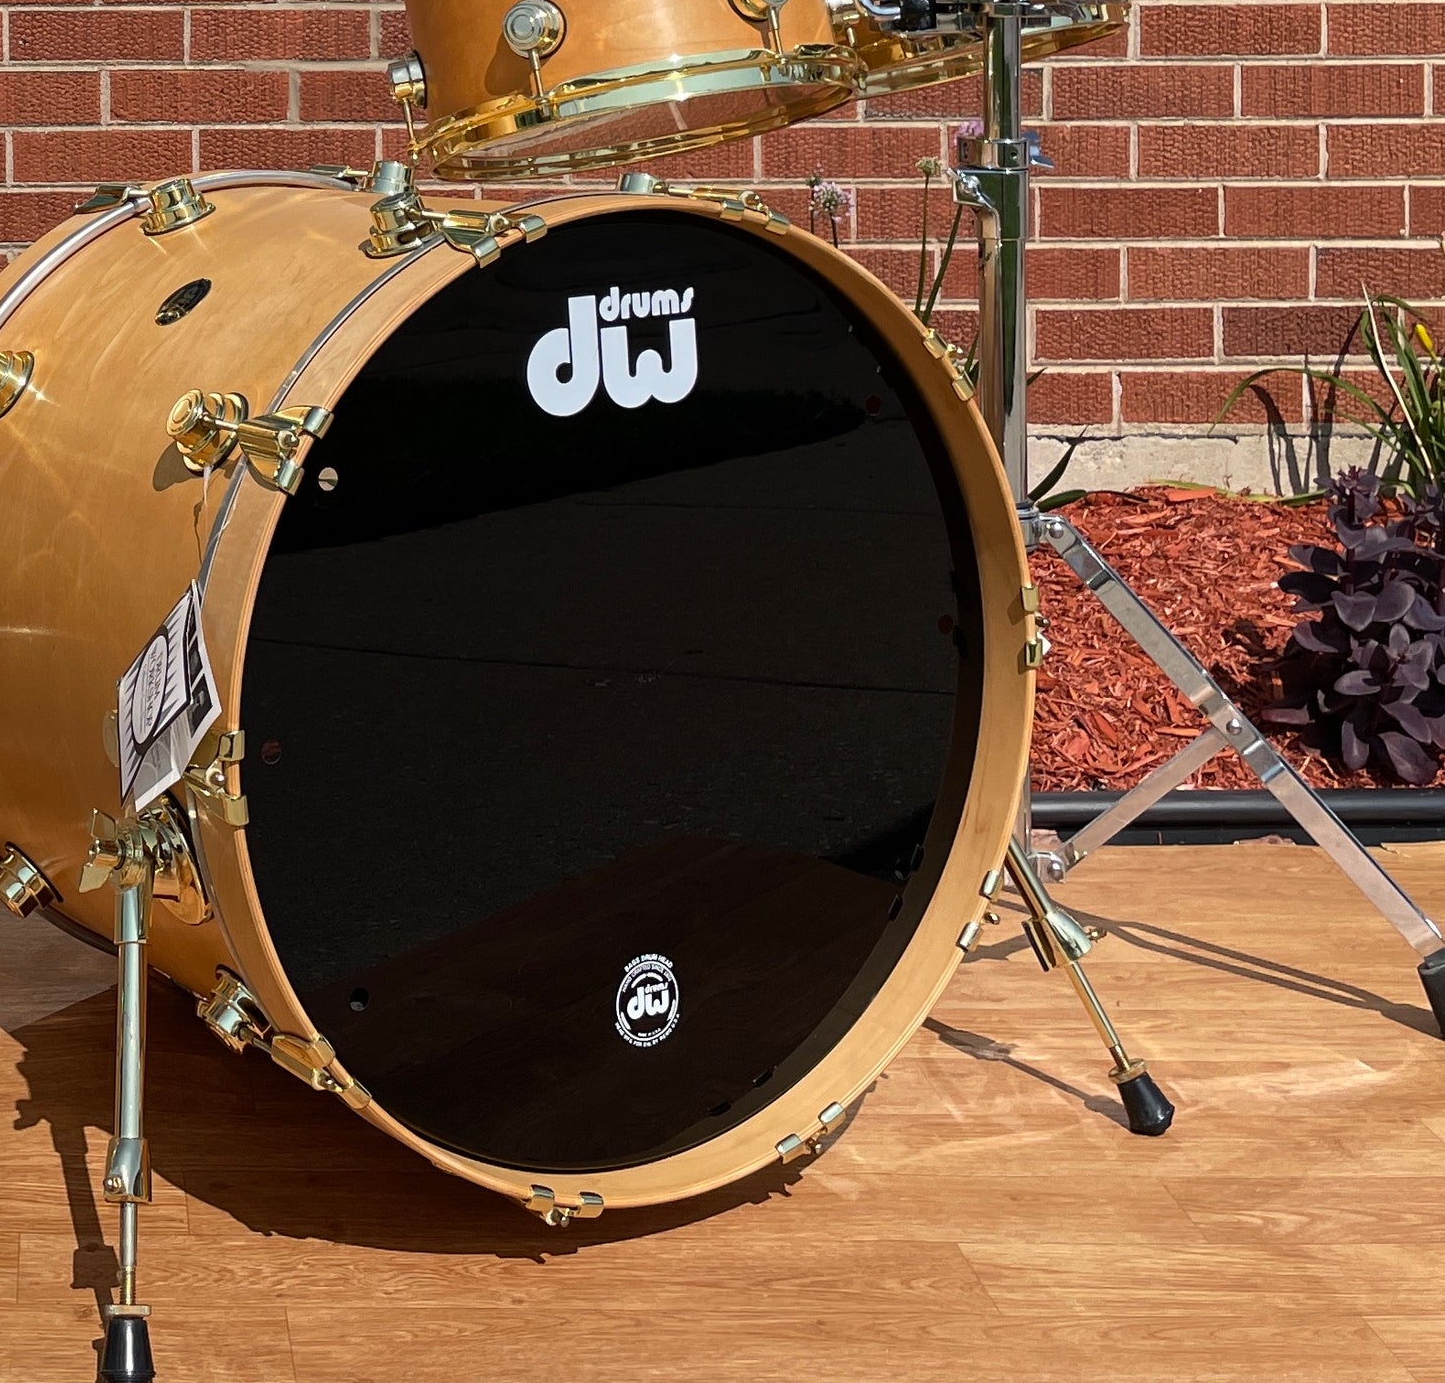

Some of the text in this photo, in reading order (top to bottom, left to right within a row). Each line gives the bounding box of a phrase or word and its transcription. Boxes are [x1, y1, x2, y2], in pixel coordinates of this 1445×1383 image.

[599, 286, 695, 322] drums
[527, 295, 698, 417] dw
[627, 986, 670, 1020] dw
[645, 982, 669, 994] drums
